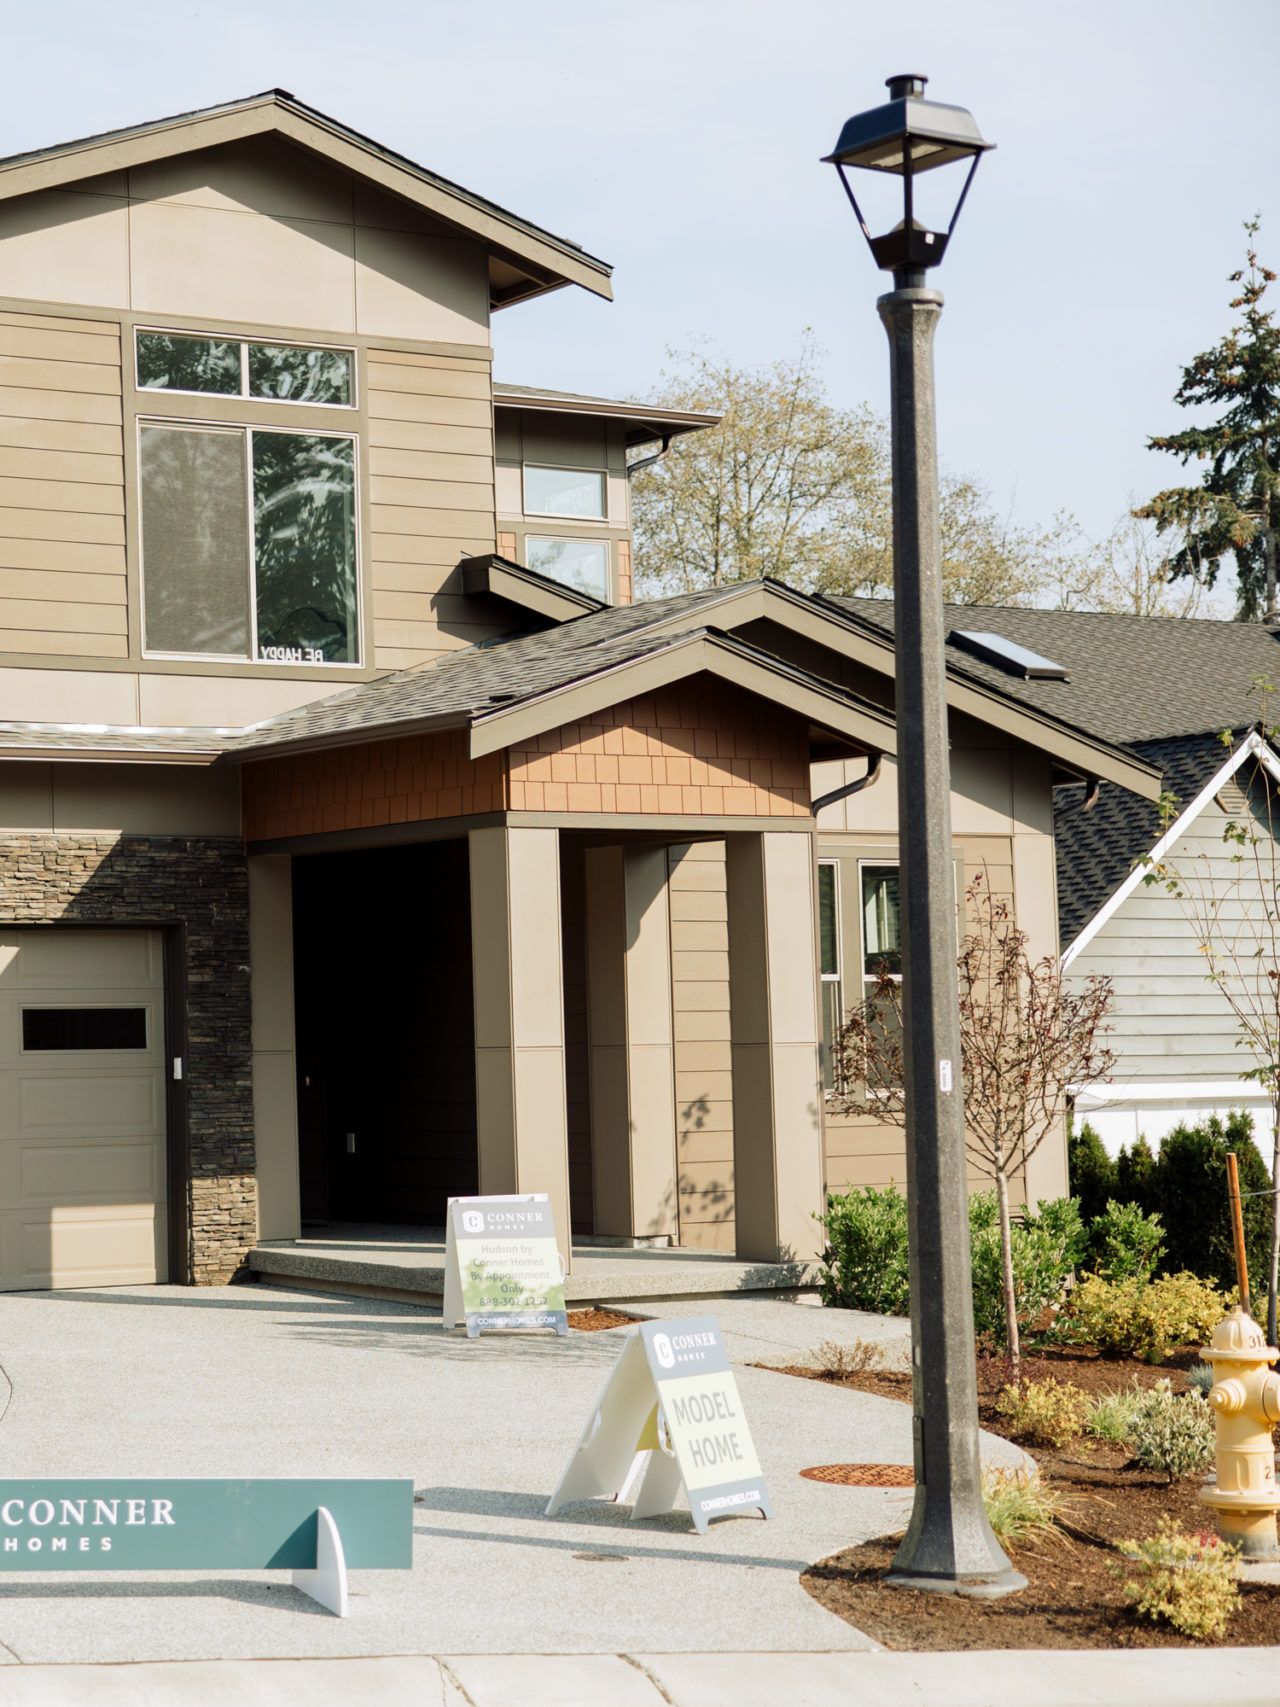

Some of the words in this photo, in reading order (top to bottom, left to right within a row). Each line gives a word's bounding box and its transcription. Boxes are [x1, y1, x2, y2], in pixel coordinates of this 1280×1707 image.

[487, 1212, 544, 1223] CONNER
[481, 1244, 519, 1254] Hudson
[521, 1244, 533, 1256] by
[473, 1258, 508, 1267] Conner
[510, 1257, 544, 1266] Homes
[470, 1271, 482, 1283] By
[486, 1270, 551, 1283] Appointment
[500, 1283, 525, 1295] Only
[477, 1316, 557, 1325] CONNERHOMES.COM
[672, 1332, 717, 1350] CONNER
[677, 1351, 705, 1363] HOMES
[672, 1390, 736, 1426] MODEL
[688, 1433, 743, 1468] HOME
[700, 1490, 761, 1512] CONNERHOMES.COM
[1, 1498, 176, 1526] CONNER
[4, 1537, 113, 1552] HOMES
